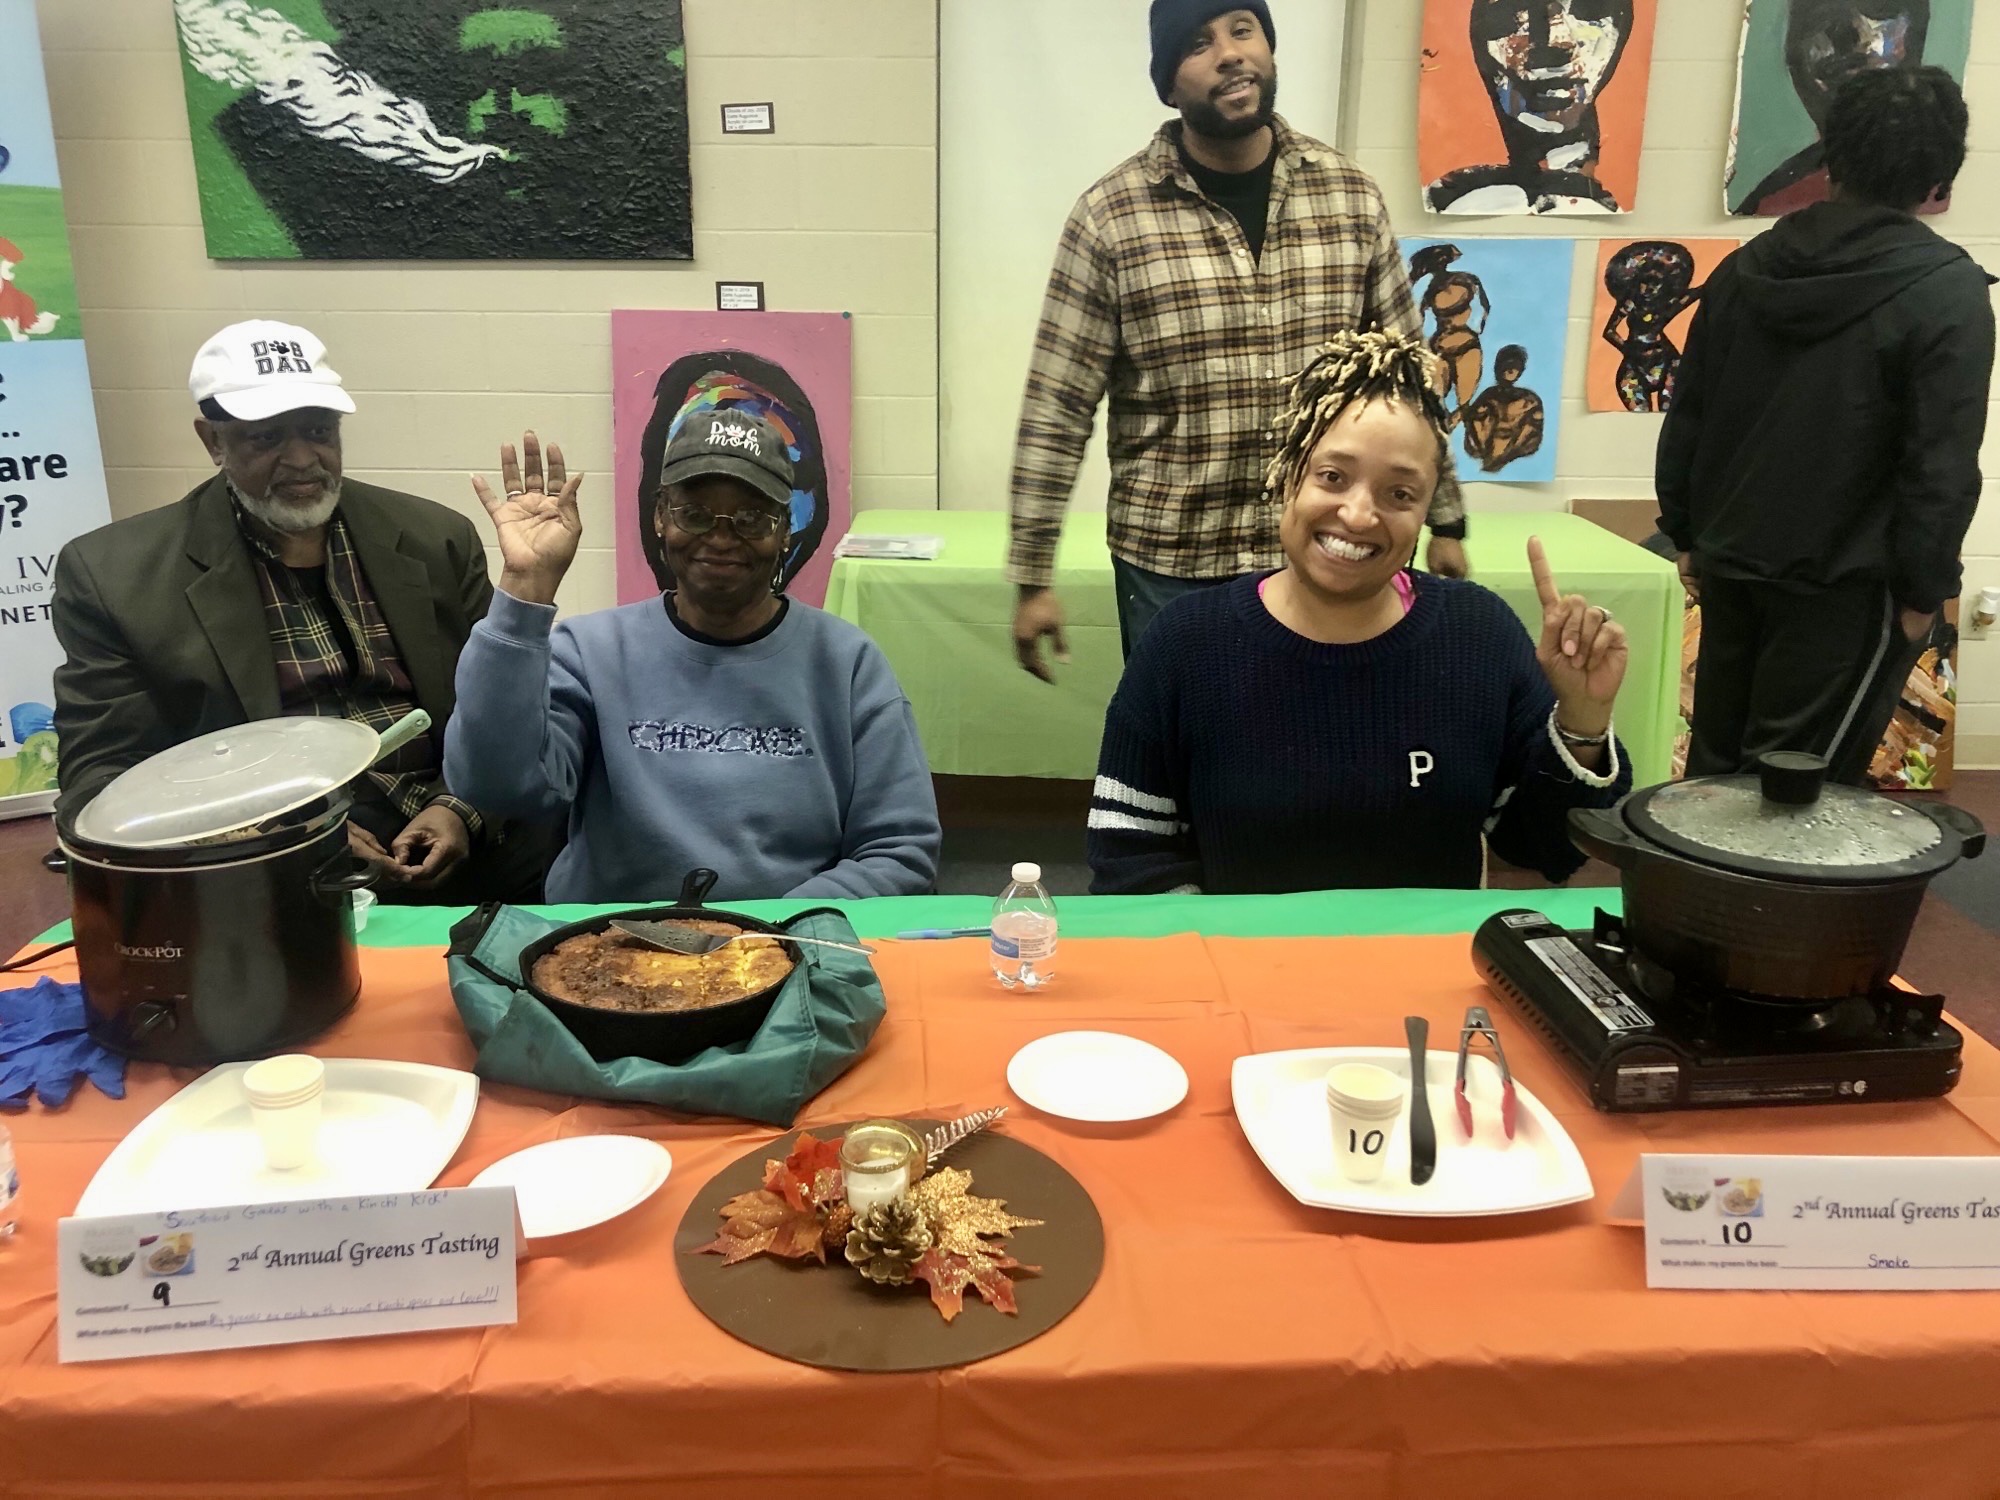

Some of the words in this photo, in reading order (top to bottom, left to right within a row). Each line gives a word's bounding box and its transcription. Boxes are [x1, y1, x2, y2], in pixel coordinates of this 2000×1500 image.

[255, 356, 313, 375] DAD
[1408, 750, 1434, 788] P
[1349, 1128, 1385, 1156] 10
[1792, 1195, 1822, 1219] 2nd
[1825, 1197, 1900, 1219] Annual
[1901, 1201, 1960, 1225] Greens
[1722, 1221, 1752, 1245] 10
[265, 1239, 348, 1268] Annual
[349, 1240, 416, 1267] Greens
[421, 1231, 499, 1259] Tasting
[1867, 1254, 1910, 1269] Smoke
[153, 1281, 171, 1307] 9
